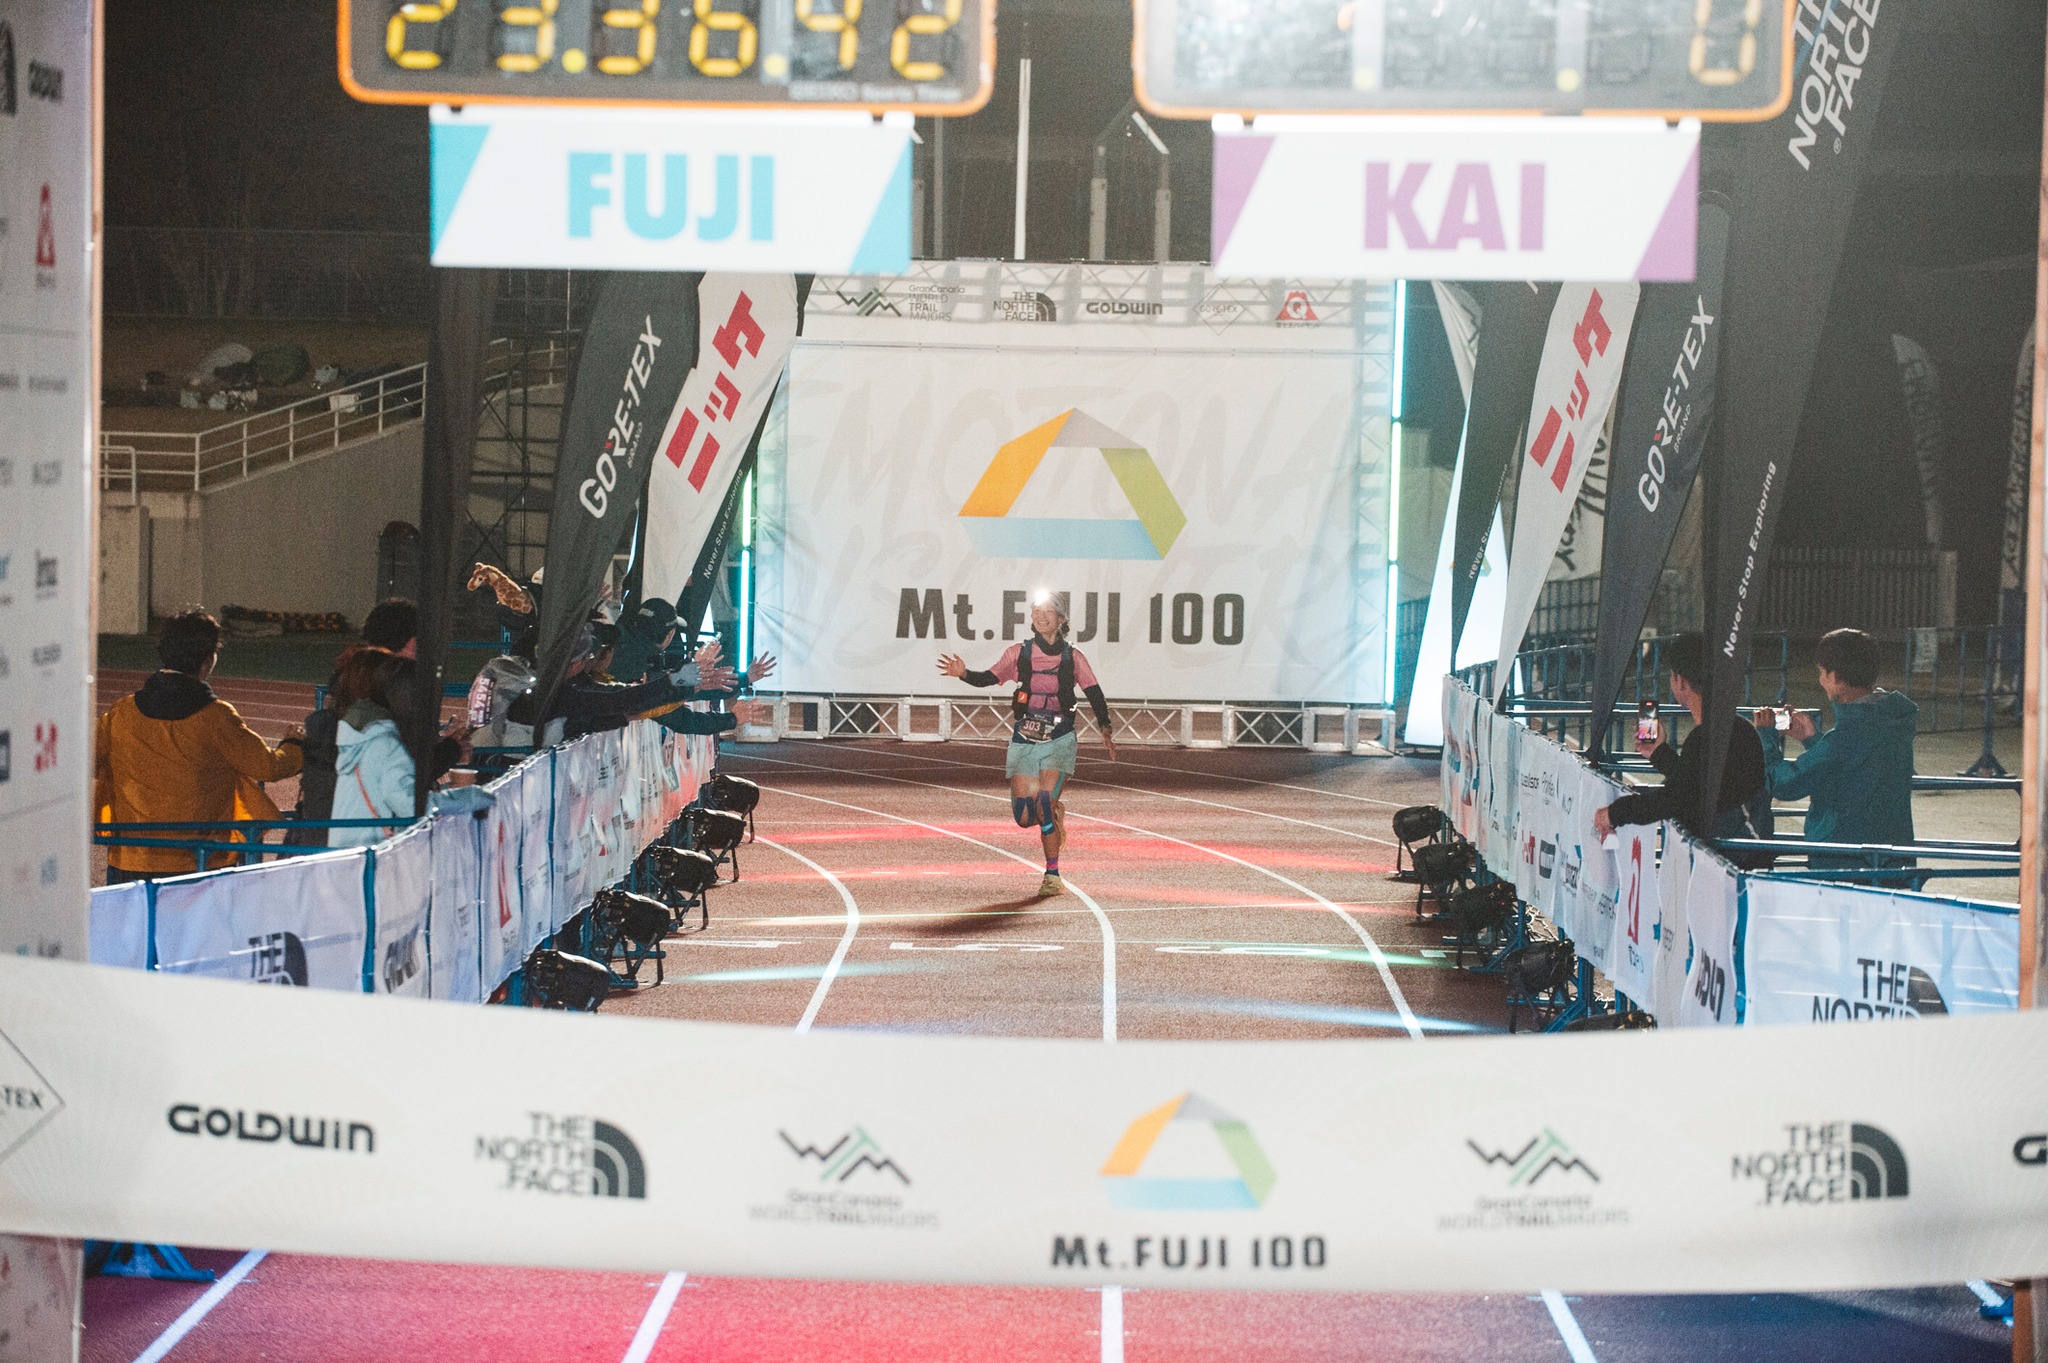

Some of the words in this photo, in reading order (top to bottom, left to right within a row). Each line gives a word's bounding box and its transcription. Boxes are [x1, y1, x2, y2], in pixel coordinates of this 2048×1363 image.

[568, 151, 774, 241] FUJI
[1363, 161, 1547, 253] KAI
[909, 294, 948, 303] WORLD
[909, 303, 938, 312] TRAIL
[993, 301, 1035, 311] NORTH
[1012, 292, 1035, 301] THE
[909, 312, 952, 321] MAJORS
[1005, 311, 1035, 321] FACE
[579, 315, 661, 518] GORE-TEX
[1638, 295, 1714, 512] GORE-TEX
[703, 547, 719, 579] Never
[715, 521, 727, 546] Stop
[724, 469, 744, 519] Exploring
[1723, 602, 1743, 657] Never
[1738, 556, 1755, 599] Stop
[1749, 461, 1777, 551] Exploring
[895, 587, 1120, 643] Mt.FJI
[1149, 592, 1245, 645] 100
[1857, 957, 1907, 1005] THE
[527, 1110, 590, 1139] THE
[1784, 1122, 1846, 1149] THE
[475, 1136, 592, 1168] NORTH
[1732, 1151, 1847, 1179] NORTH
[505, 1163, 589, 1195] FACE
[1766, 1178, 1846, 1204] FACE
[1051, 1236, 1228, 1269] Mt.FUJI
[1252, 1236, 1326, 1269] 100
